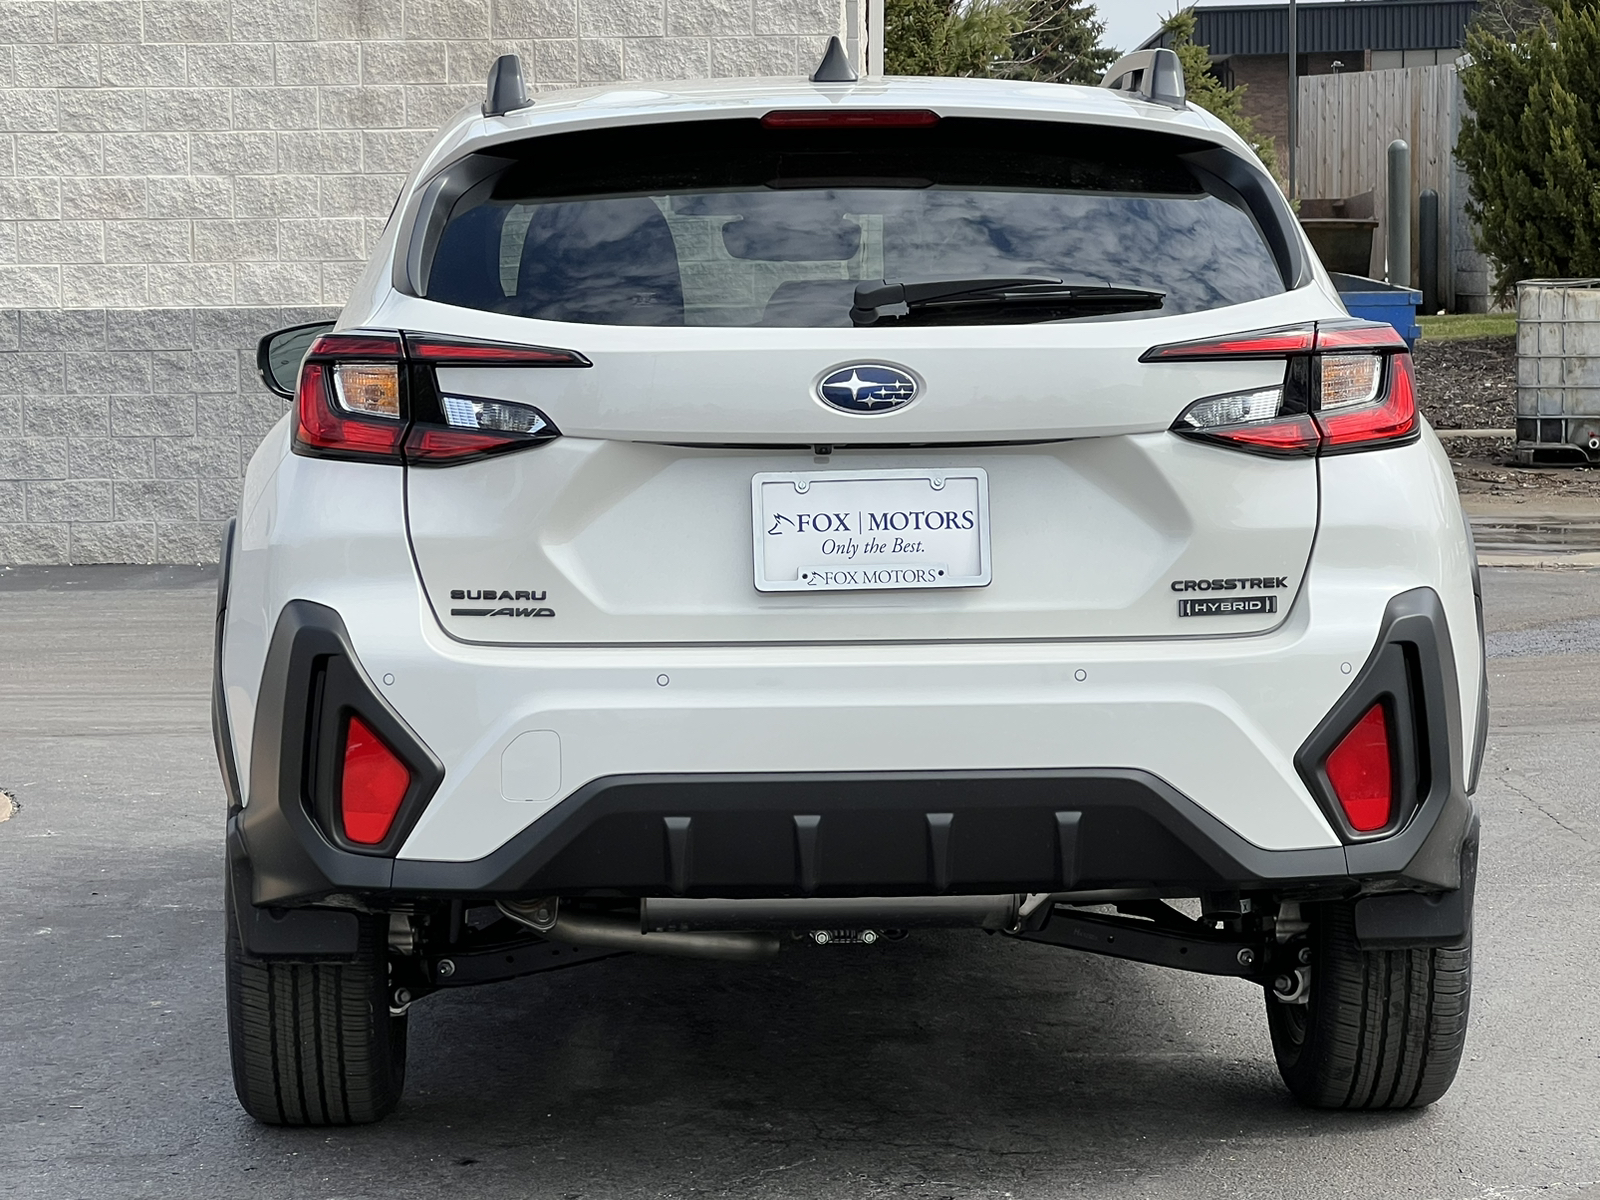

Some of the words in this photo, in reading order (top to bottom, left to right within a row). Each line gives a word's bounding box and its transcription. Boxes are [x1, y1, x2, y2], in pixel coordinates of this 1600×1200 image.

[797, 512, 851, 533] FOX
[868, 510, 974, 531] MOTORS
[821, 538, 859, 560] Only
[863, 537, 887, 554] the
[891, 537, 925, 553] Best.
[824, 571, 858, 585] FOX
[862, 568, 936, 584] MOTORS
[1171, 576, 1288, 592] CROSSTREK
[450, 589, 547, 601] SUBARU
[489, 607, 556, 618] AWD
[1194, 601, 1262, 612] HYBRID
